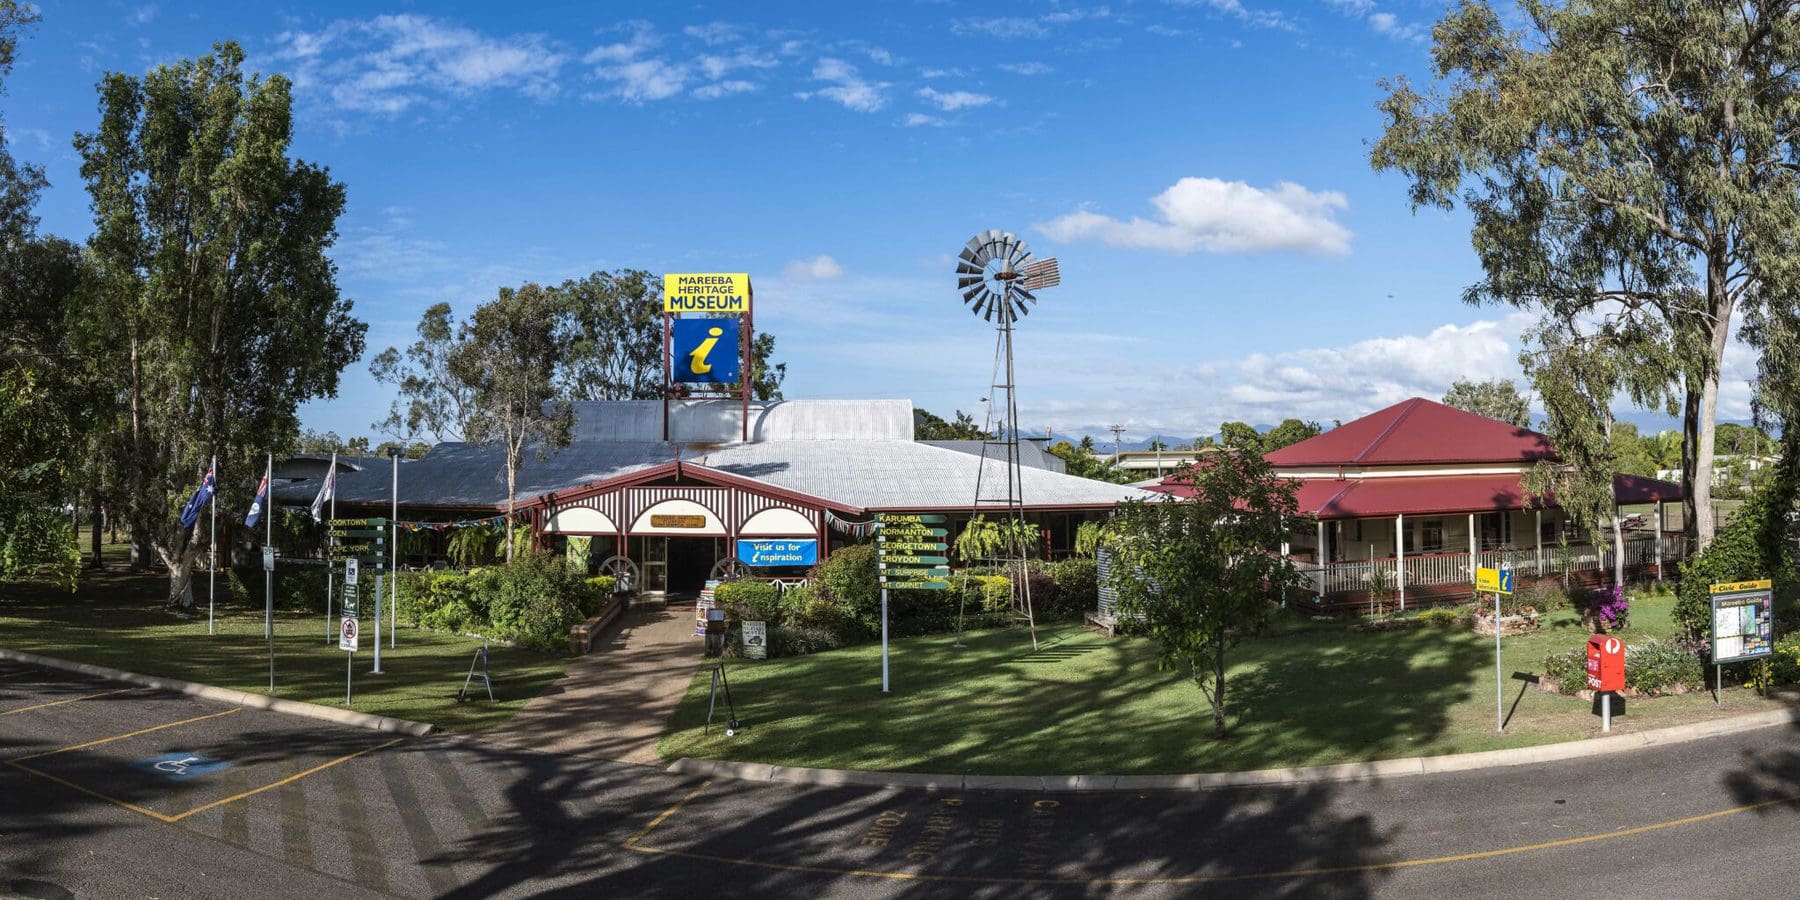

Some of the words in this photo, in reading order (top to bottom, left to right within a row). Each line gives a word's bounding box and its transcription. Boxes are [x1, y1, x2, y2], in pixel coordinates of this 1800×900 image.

[679, 276, 733, 285] MAREEBA
[678, 286, 734, 294] HERITAGE
[670, 296, 742, 309] MUSEUM
[328, 519, 367, 527] COOKTOWN
[879, 515, 921, 523] KARUMBA
[880, 528, 934, 536] NORMANTON
[753, 543, 773, 551] Visit
[788, 543, 801, 551] for
[880, 542, 937, 550] GEORGETOWN
[860, 810, 907, 847] ZONE
